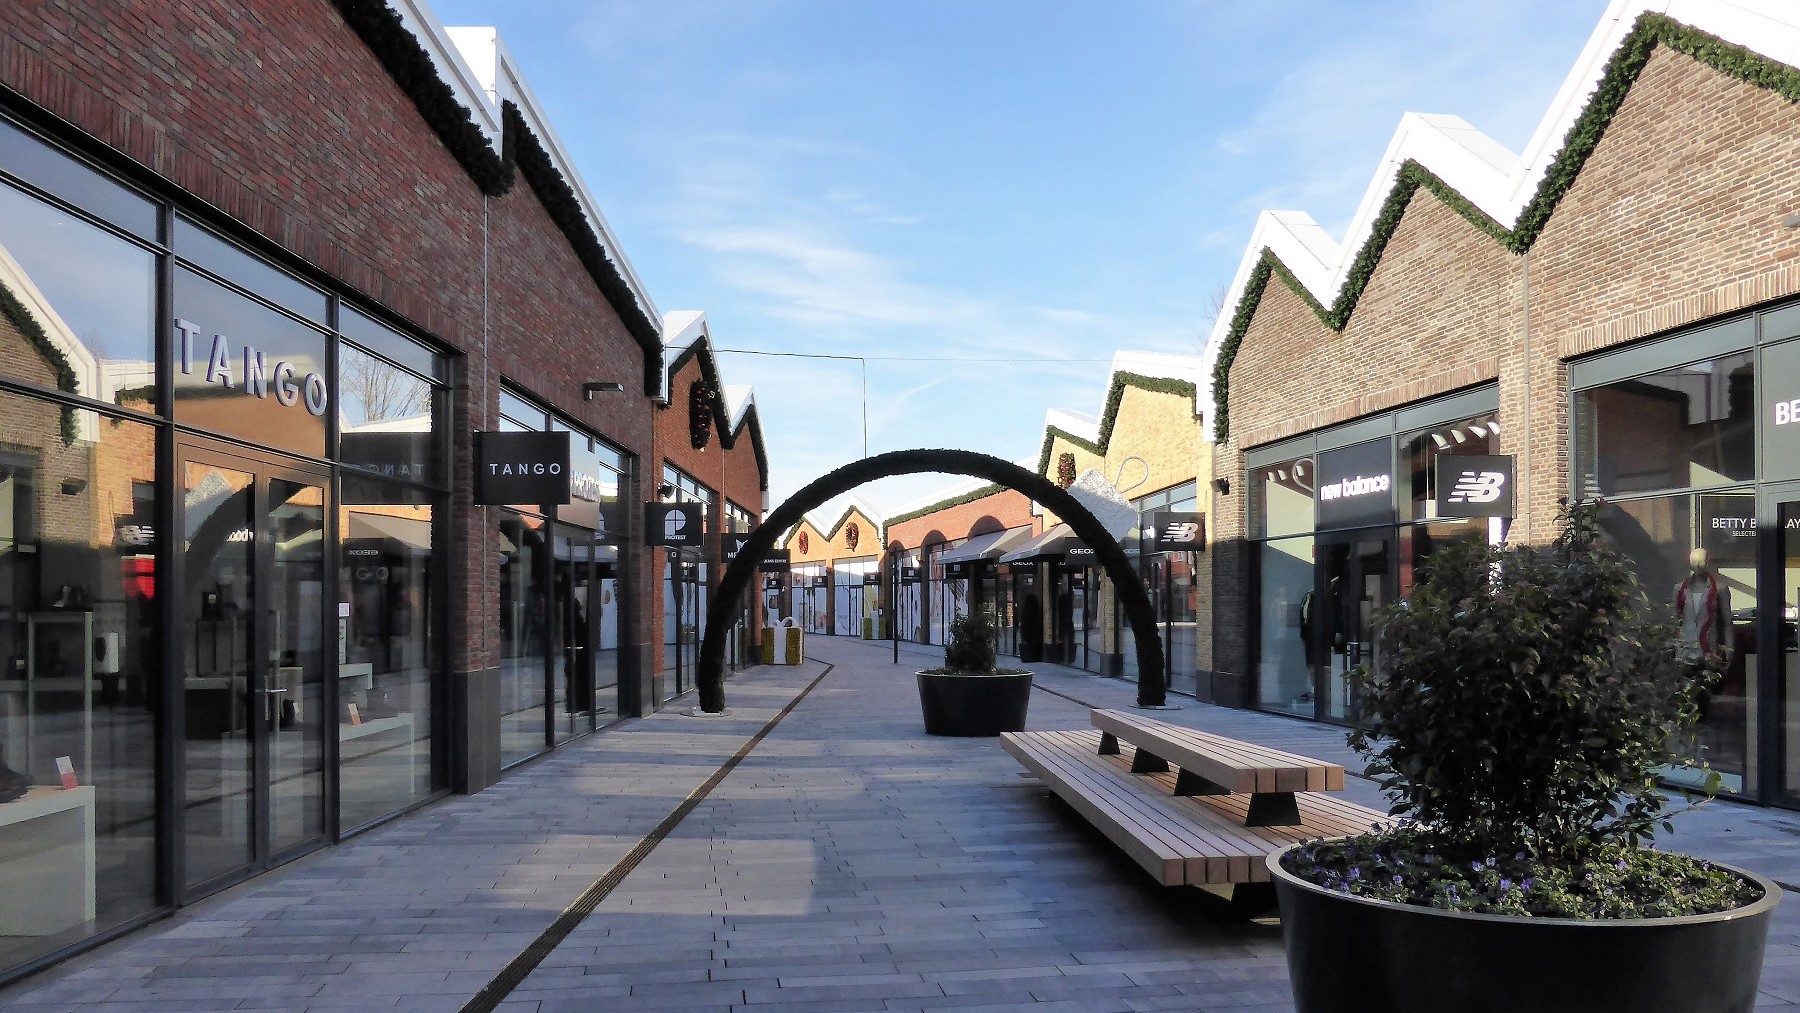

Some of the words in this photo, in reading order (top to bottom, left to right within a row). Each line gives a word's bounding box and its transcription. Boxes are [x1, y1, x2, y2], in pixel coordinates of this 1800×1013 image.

[174, 318, 328, 416] TANGO
[489, 463, 561, 475] TANGO
[1320, 483, 1342, 501] new
[1342, 474, 1390, 498] balance
[1712, 517, 1747, 529] BETTY
